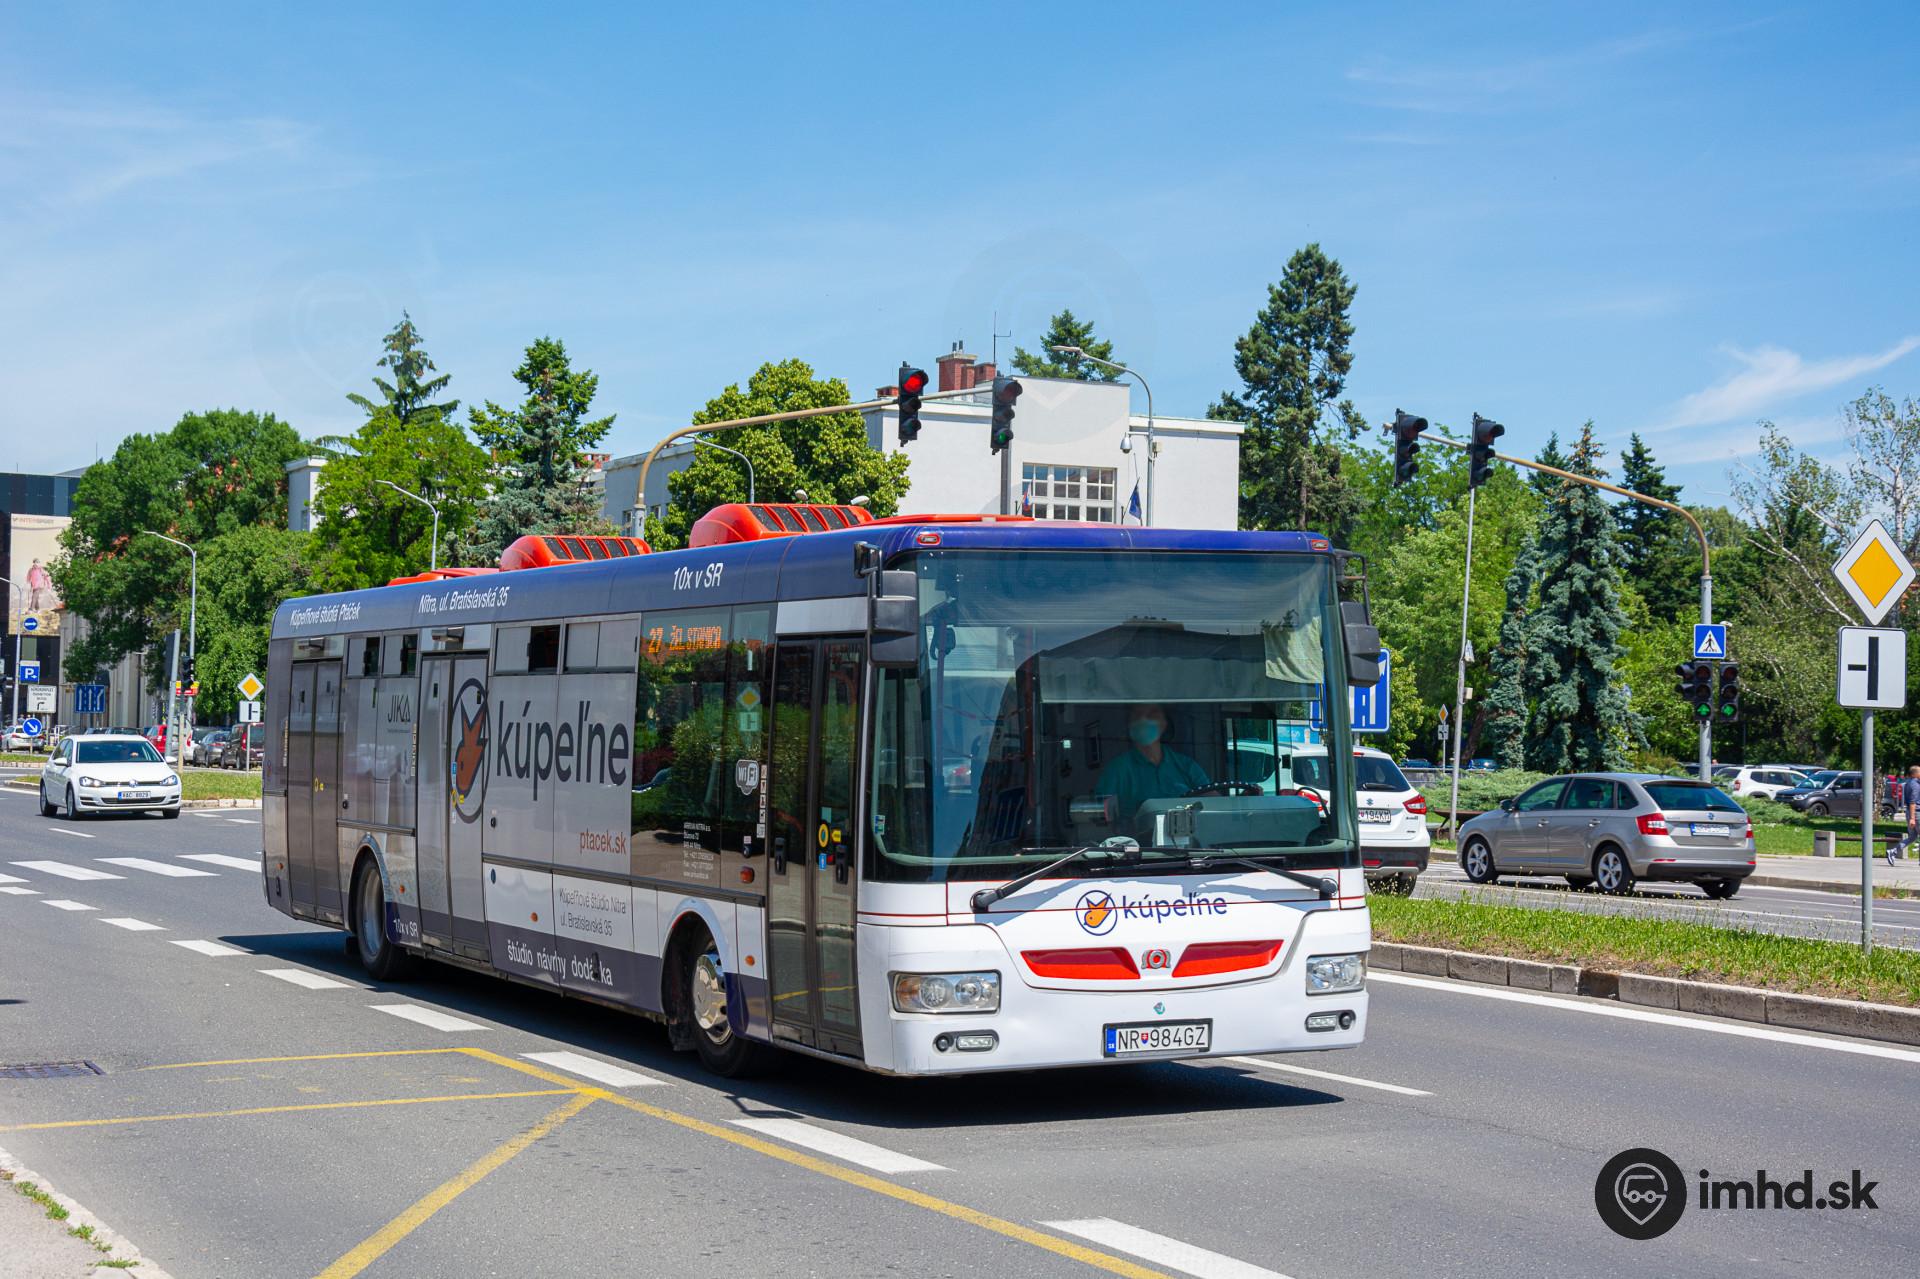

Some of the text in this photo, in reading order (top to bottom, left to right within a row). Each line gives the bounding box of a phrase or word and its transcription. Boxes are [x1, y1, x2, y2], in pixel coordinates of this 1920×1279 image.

[673, 562, 724, 590] 10x v SR
[418, 586, 511, 615] Nitra, ul. Bratislavská 35
[647, 627, 664, 653] 27
[387, 694, 411, 723] JIKA
[496, 700, 630, 802] kúpeľne
[580, 827, 627, 856] ptacek.sk
[610, 896, 627, 914] Nitra
[1122, 891, 1228, 924] kúpeľne
[603, 919, 613, 936] 35
[507, 939, 614, 987] štúdio návrhy dodáka
[1118, 1026, 1206, 1050] NR 984GZ
